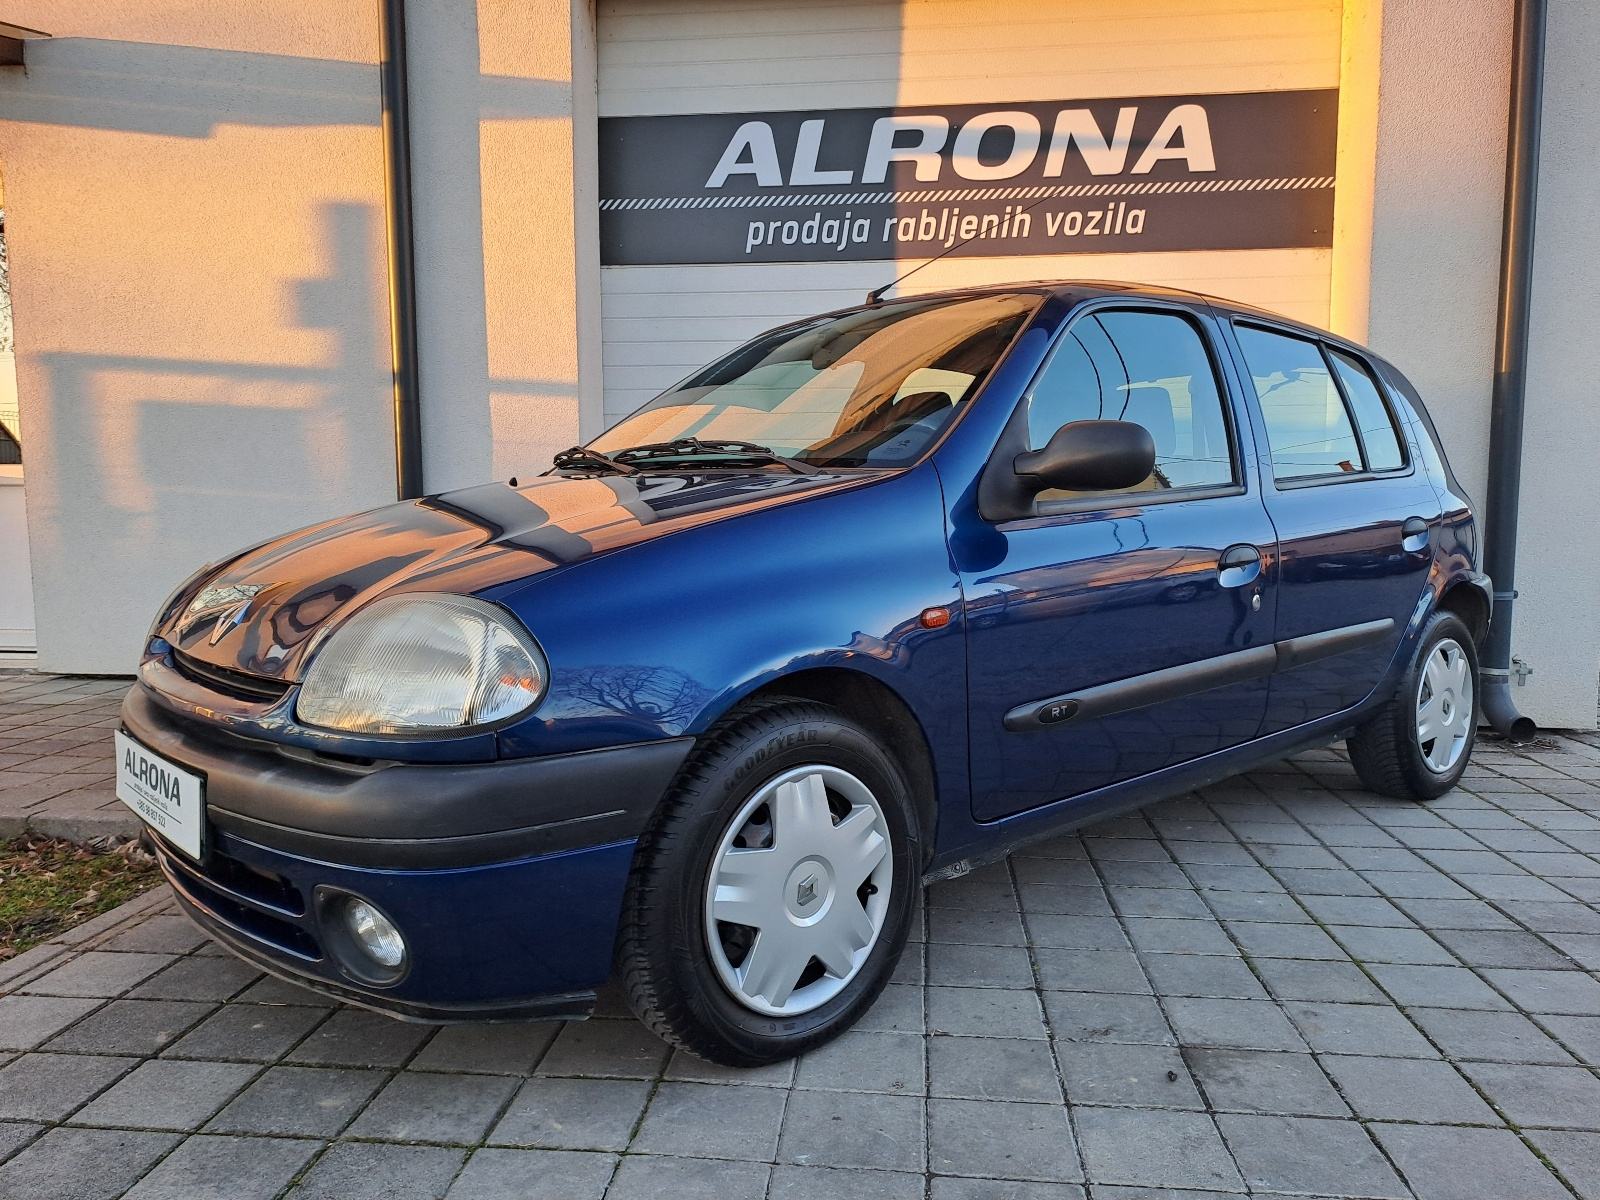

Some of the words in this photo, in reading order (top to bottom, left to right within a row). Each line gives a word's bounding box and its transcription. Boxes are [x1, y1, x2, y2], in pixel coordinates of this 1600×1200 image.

[705, 104, 1216, 188] ALRONA
[745, 212, 871, 254] prodaja
[882, 206, 1032, 248] rabljenih
[1046, 202, 1146, 237] vozila
[1051, 705, 1068, 718] RT
[125, 747, 181, 807] ALRONA
